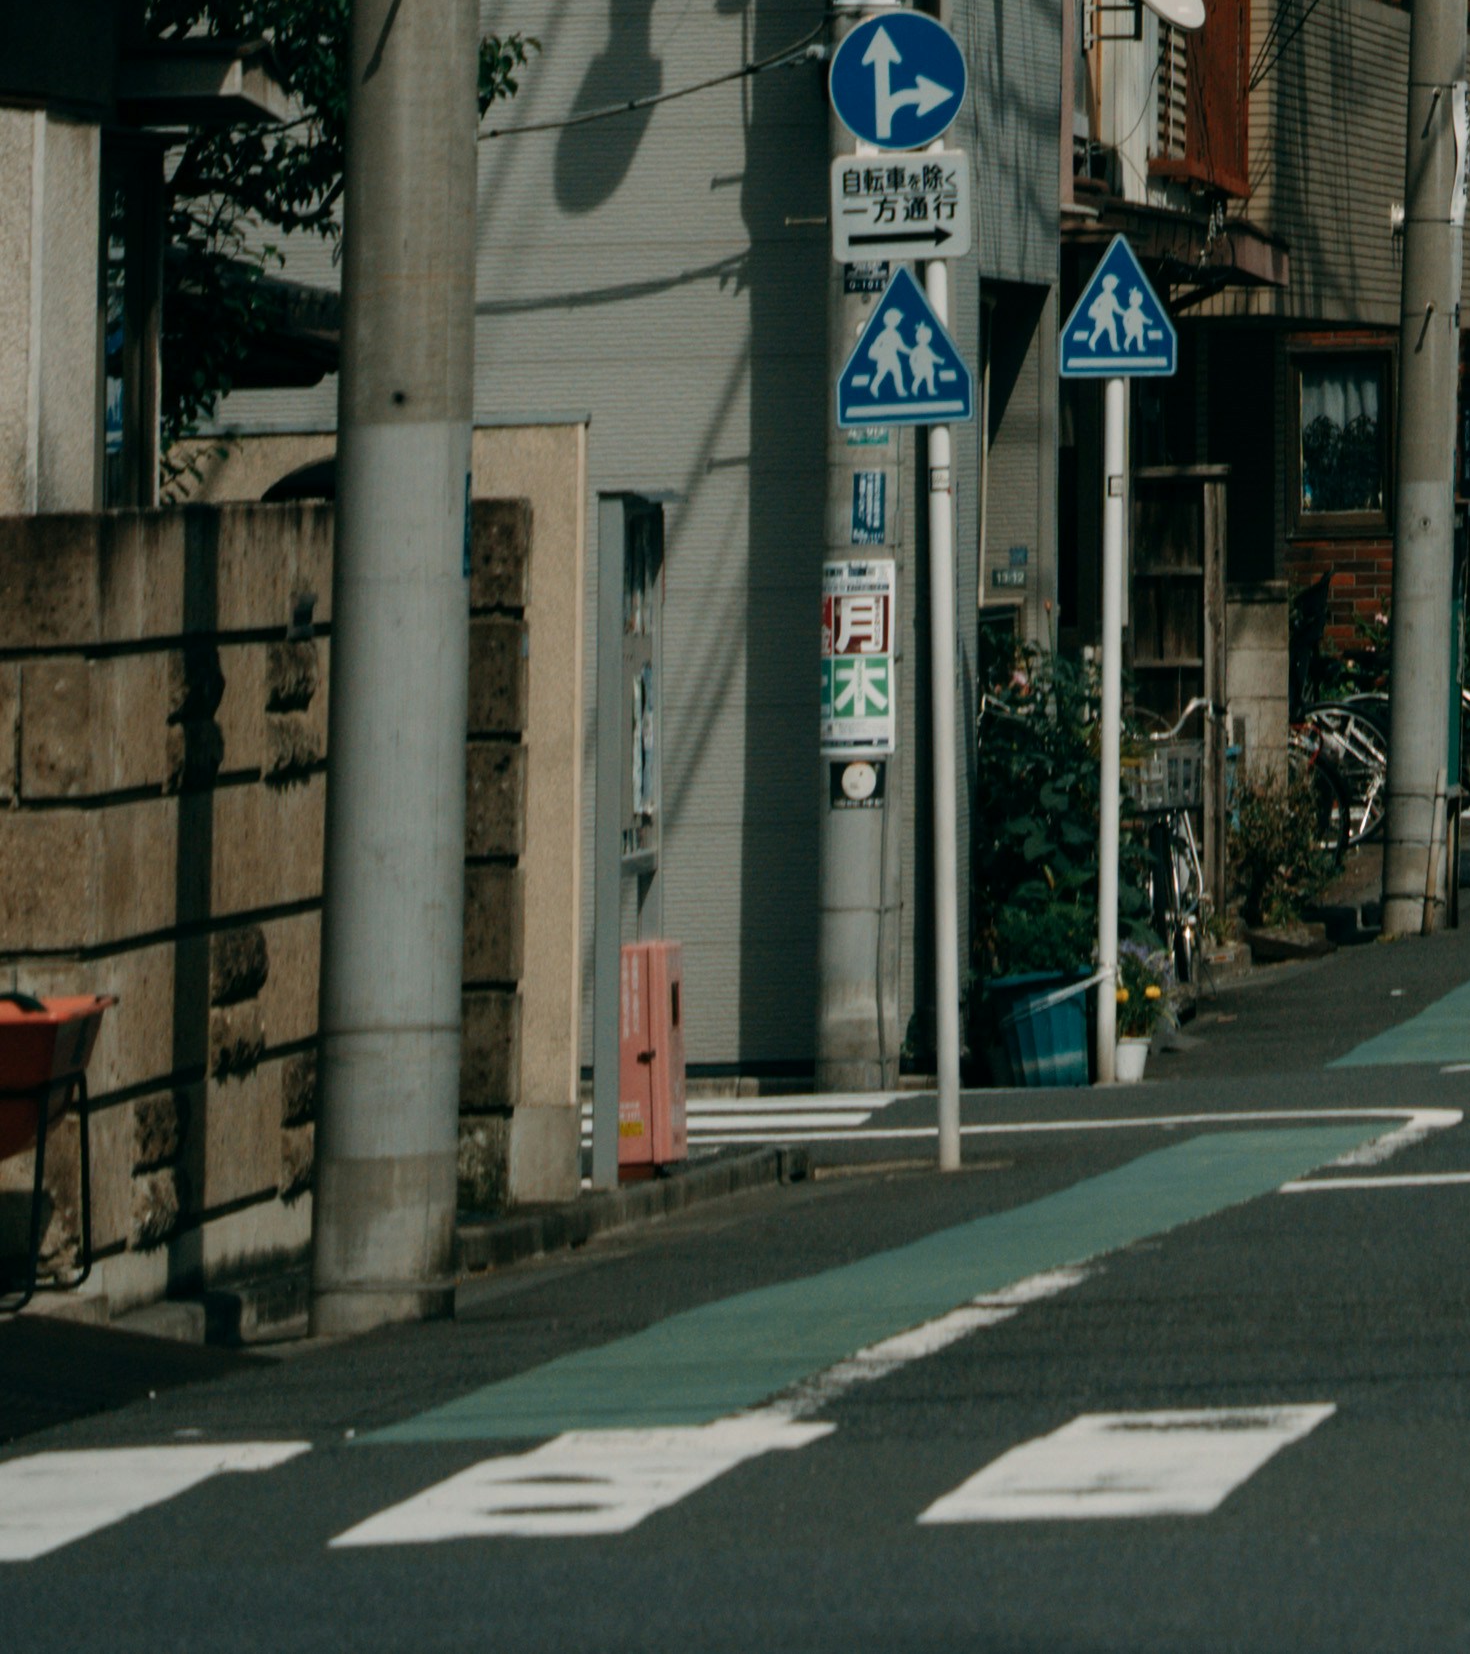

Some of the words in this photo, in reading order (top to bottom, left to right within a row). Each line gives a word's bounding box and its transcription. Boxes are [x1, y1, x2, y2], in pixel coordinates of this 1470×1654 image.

[843, 164, 957, 194] 自転車を除く
[842, 190, 958, 224] 一方通行
[835, 597, 883, 653] 月
[835, 658, 888, 717] 木
